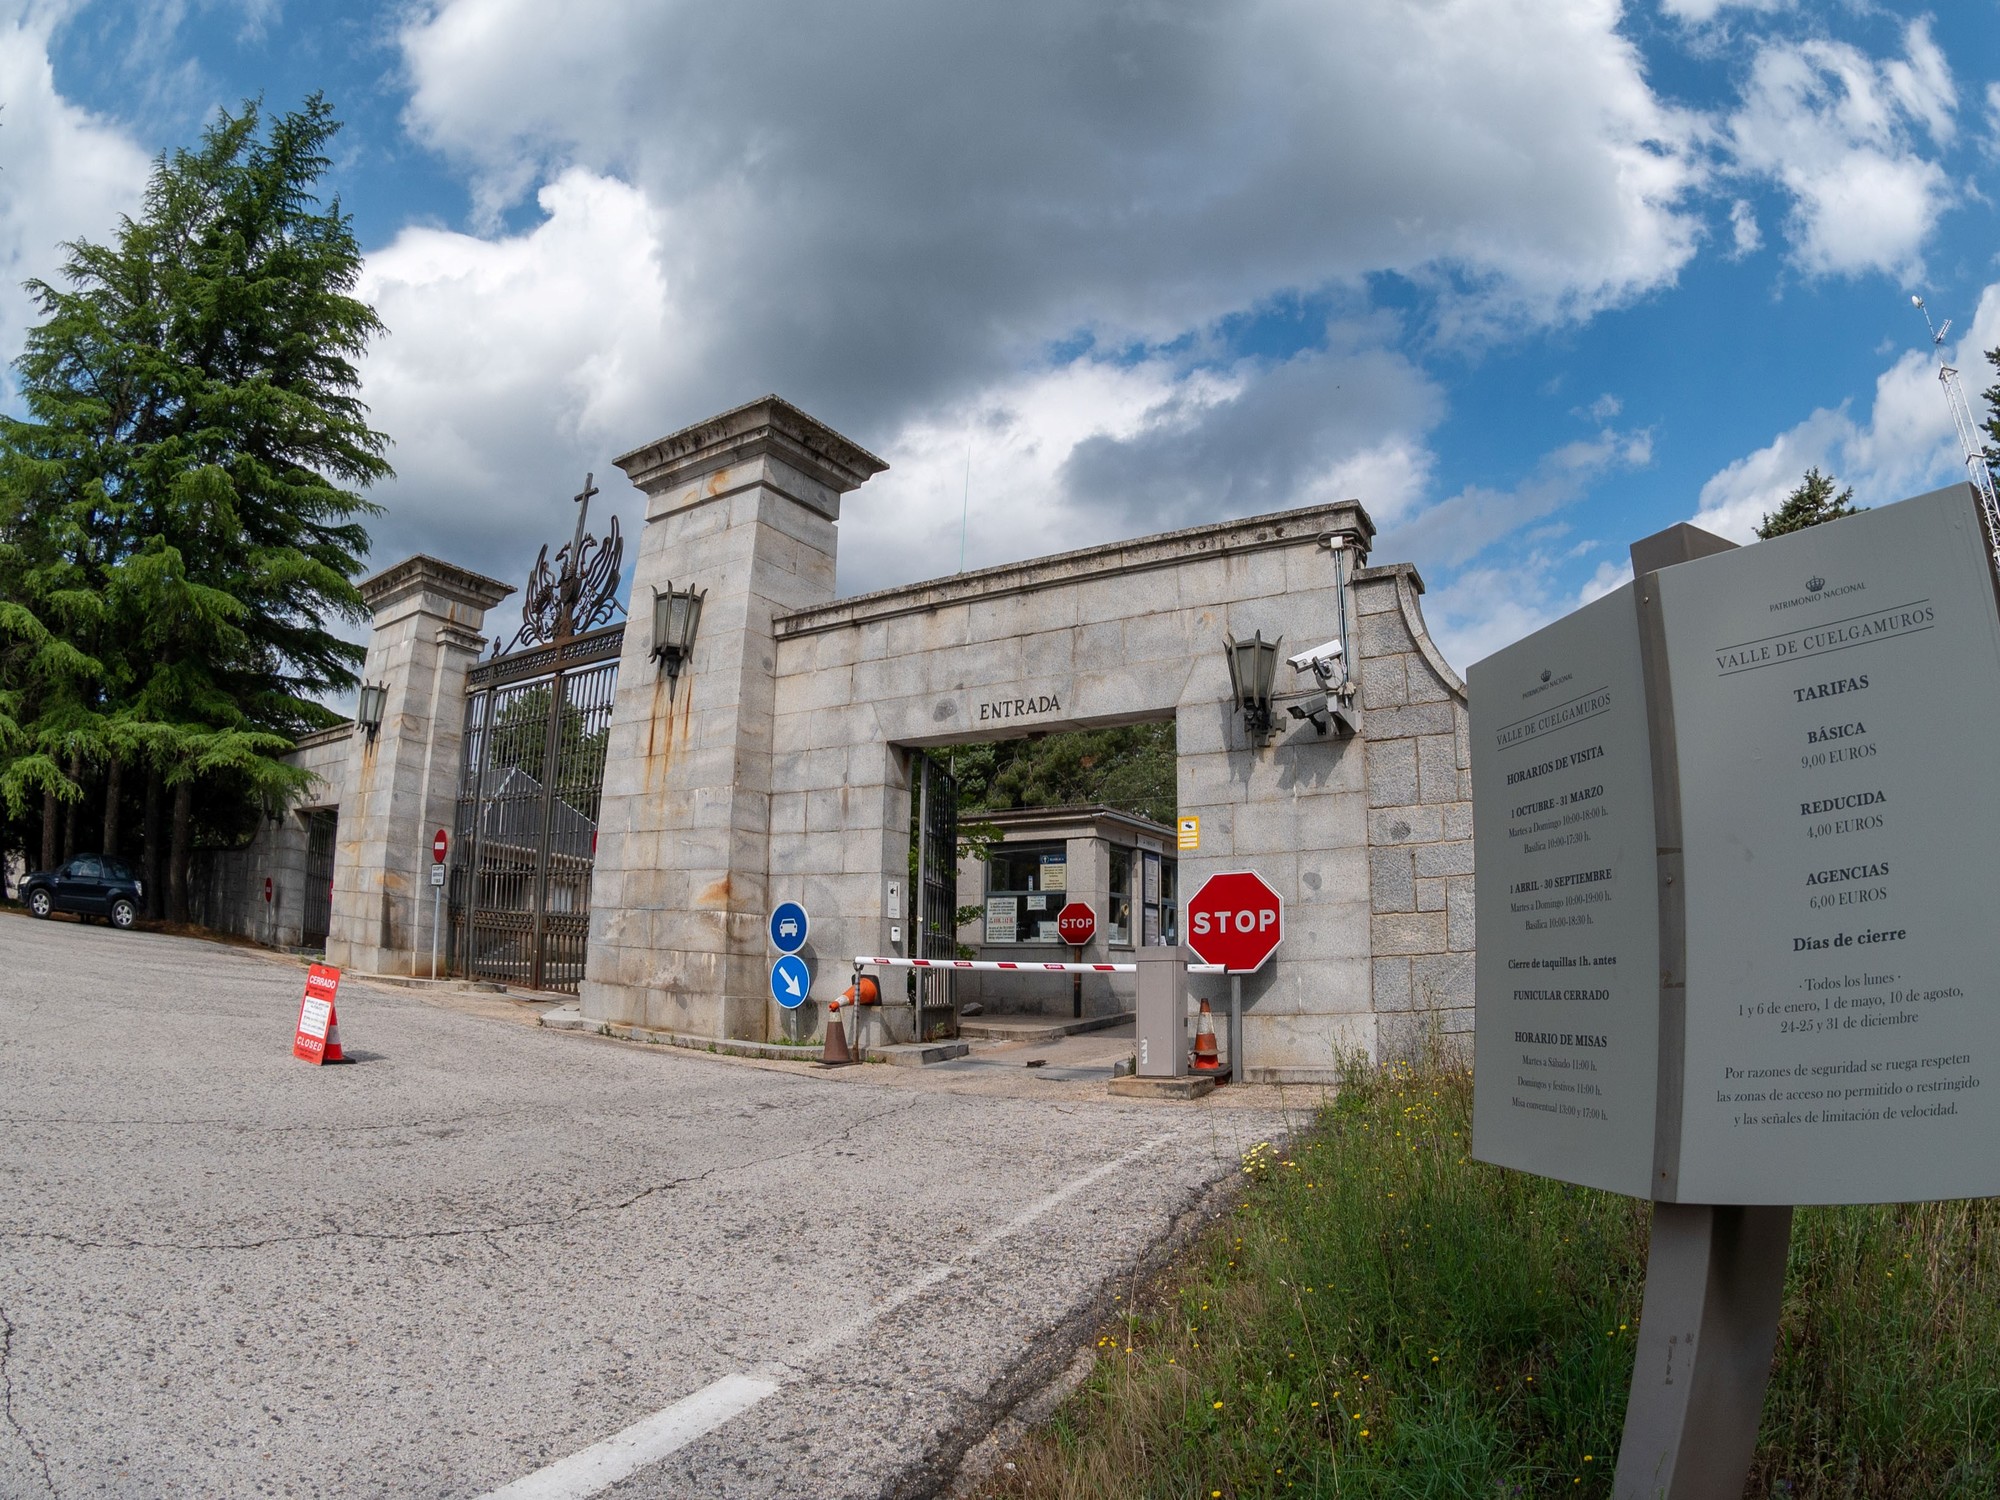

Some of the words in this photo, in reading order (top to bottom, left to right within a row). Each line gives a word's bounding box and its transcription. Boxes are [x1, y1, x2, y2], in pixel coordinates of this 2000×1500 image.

[1769, 593, 1821, 612] PATRIMONIO
[1824, 582, 1866, 598] NACIONAL
[1717, 647, 1770, 669] VALLE
[1776, 640, 1798, 656] DE
[1803, 608, 1934, 650] CUELGAMUROS
[1522, 683, 1548, 700] PATRIMONIO
[1550, 673, 1572, 687] NACIONAL
[1794, 675, 1868, 702] TARIFAS
[980, 694, 1061, 720] ENTRADA
[1497, 727, 1522, 745] VALLE
[1525, 722, 1535, 735] DE
[1538, 693, 1610, 730] CUELGAMUROS
[1808, 722, 1866, 744] BÁSICA
[1507, 761, 1553, 785] HORARIOS
[1556, 756, 1568, 770] DE
[1571, 745, 1604, 766] VISITA
[1801, 753, 1826, 769] 9,00
[1830, 743, 1876, 764] EUROS
[1517, 799, 1554, 817] OCTUBRE
[1560, 796, 1568, 806] 31
[1570, 785, 1603, 803] MARZO
[1800, 790, 1886, 816] REDUCIDA
[1509, 824, 1527, 838] Martes
[1533, 816, 1561, 833] Domingo
[1807, 823, 1832, 838] 4,00
[1835, 815, 1883, 834] EUROS
[1515, 880, 1539, 893] ABRIL
[1544, 879, 1553, 889] 30
[1554, 869, 1612, 888] SEPTIEMBRE
[1806, 862, 1889, 886] AGENCIAS
[1510, 902, 1529, 912] Martes
[1536, 898, 1564, 911] Domingo
[1810, 895, 1835, 910] 6,00
[1839, 888, 1887, 906] EUROS
[1061, 918, 1092, 928] STOP
[1193, 909, 1276, 934] STOP
[1793, 935, 1829, 952] Días
[1834, 933, 1852, 947] de
[1858, 930, 1906, 945] cierre
[1508, 958, 1530, 969] Cierre
[1532, 959, 1540, 968] de
[1542, 957, 1576, 970] taquillas
[1579, 957, 1591, 966] 1h.
[1593, 956, 1616, 966] antes
[310, 975, 336, 989] CERRADO
[1804, 978, 1840, 991] Todos
[1844, 975, 1860, 988] los
[1864, 973, 1894, 986] lunes
[1514, 991, 1562, 1000] FUNICULAR
[1564, 990, 1609, 1001] CERRADO
[1738, 1005, 1742, 1016] 1
[1748, 1008, 1754, 1017] y
[1757, 1004, 1764, 1015] 6
[1767, 1002, 1781, 1014] de
[1784, 1000, 1820, 1014] enero,
[1825, 999, 1828, 1010] 1
[1834, 998, 1848, 1010] de
[1851, 996, 1886, 1009] mayo,
[1890, 992, 1902, 1003] 10
[1906, 989, 1920, 1002] de
[1923, 986, 1964, 1002] agosto,
[1780, 1020, 1813, 1033] 24-25
[1816, 1022, 1823, 1033] y
[1826, 1018, 1839, 1030] 31
[1843, 1016, 1857, 1029] de
[1860, 1012, 1918, 1028] diciembre
[297, 1036, 322, 1051] CLOSED
[1515, 1032, 1558, 1044] HORARIO
[1560, 1034, 1573, 1045] DE
[1576, 1035, 1607, 1048] MISAS
[1523, 1055, 1541, 1066] Martes
[1548, 1057, 1570, 1068] Sábado
[1725, 1067, 1744, 1079] Por
[1748, 1067, 1791, 1078] razones
[1794, 1064, 1808, 1076] de
[1811, 1059, 1867, 1076] seguridad
[1870, 1062, 1882, 1071] se
[1886, 1060, 1918, 1071] ruega
[1921, 1054, 1970, 1069] respeten
[1518, 1076, 1546, 1090] Domingos
[1553, 1079, 1575, 1093] festivos
[1717, 1090, 1731, 1102] las
[1734, 1091, 1766, 1102] zonas
[1769, 1088, 1783, 1100] de
[1786, 1089, 1823, 1100] acceso
[1826, 1089, 1841, 1098] no
[1844, 1082, 1902, 1100] permitido
[1906, 1085, 1913, 1093] o
[1916, 1076, 1980, 1093] restringido
[1512, 1097, 1524, 1108] Misa
[1526, 1100, 1557, 1114] conventual
[1734, 1116, 1741, 1127] y
[1743, 1112, 1758, 1125] las
[1761, 1111, 1801, 1124] señales
[1804, 1110, 1818, 1123] de
[1822, 1108, 1880, 1122] limitación
[1883, 1107, 1897, 1120] de
[1900, 1102, 1958, 1118] velocidad.
